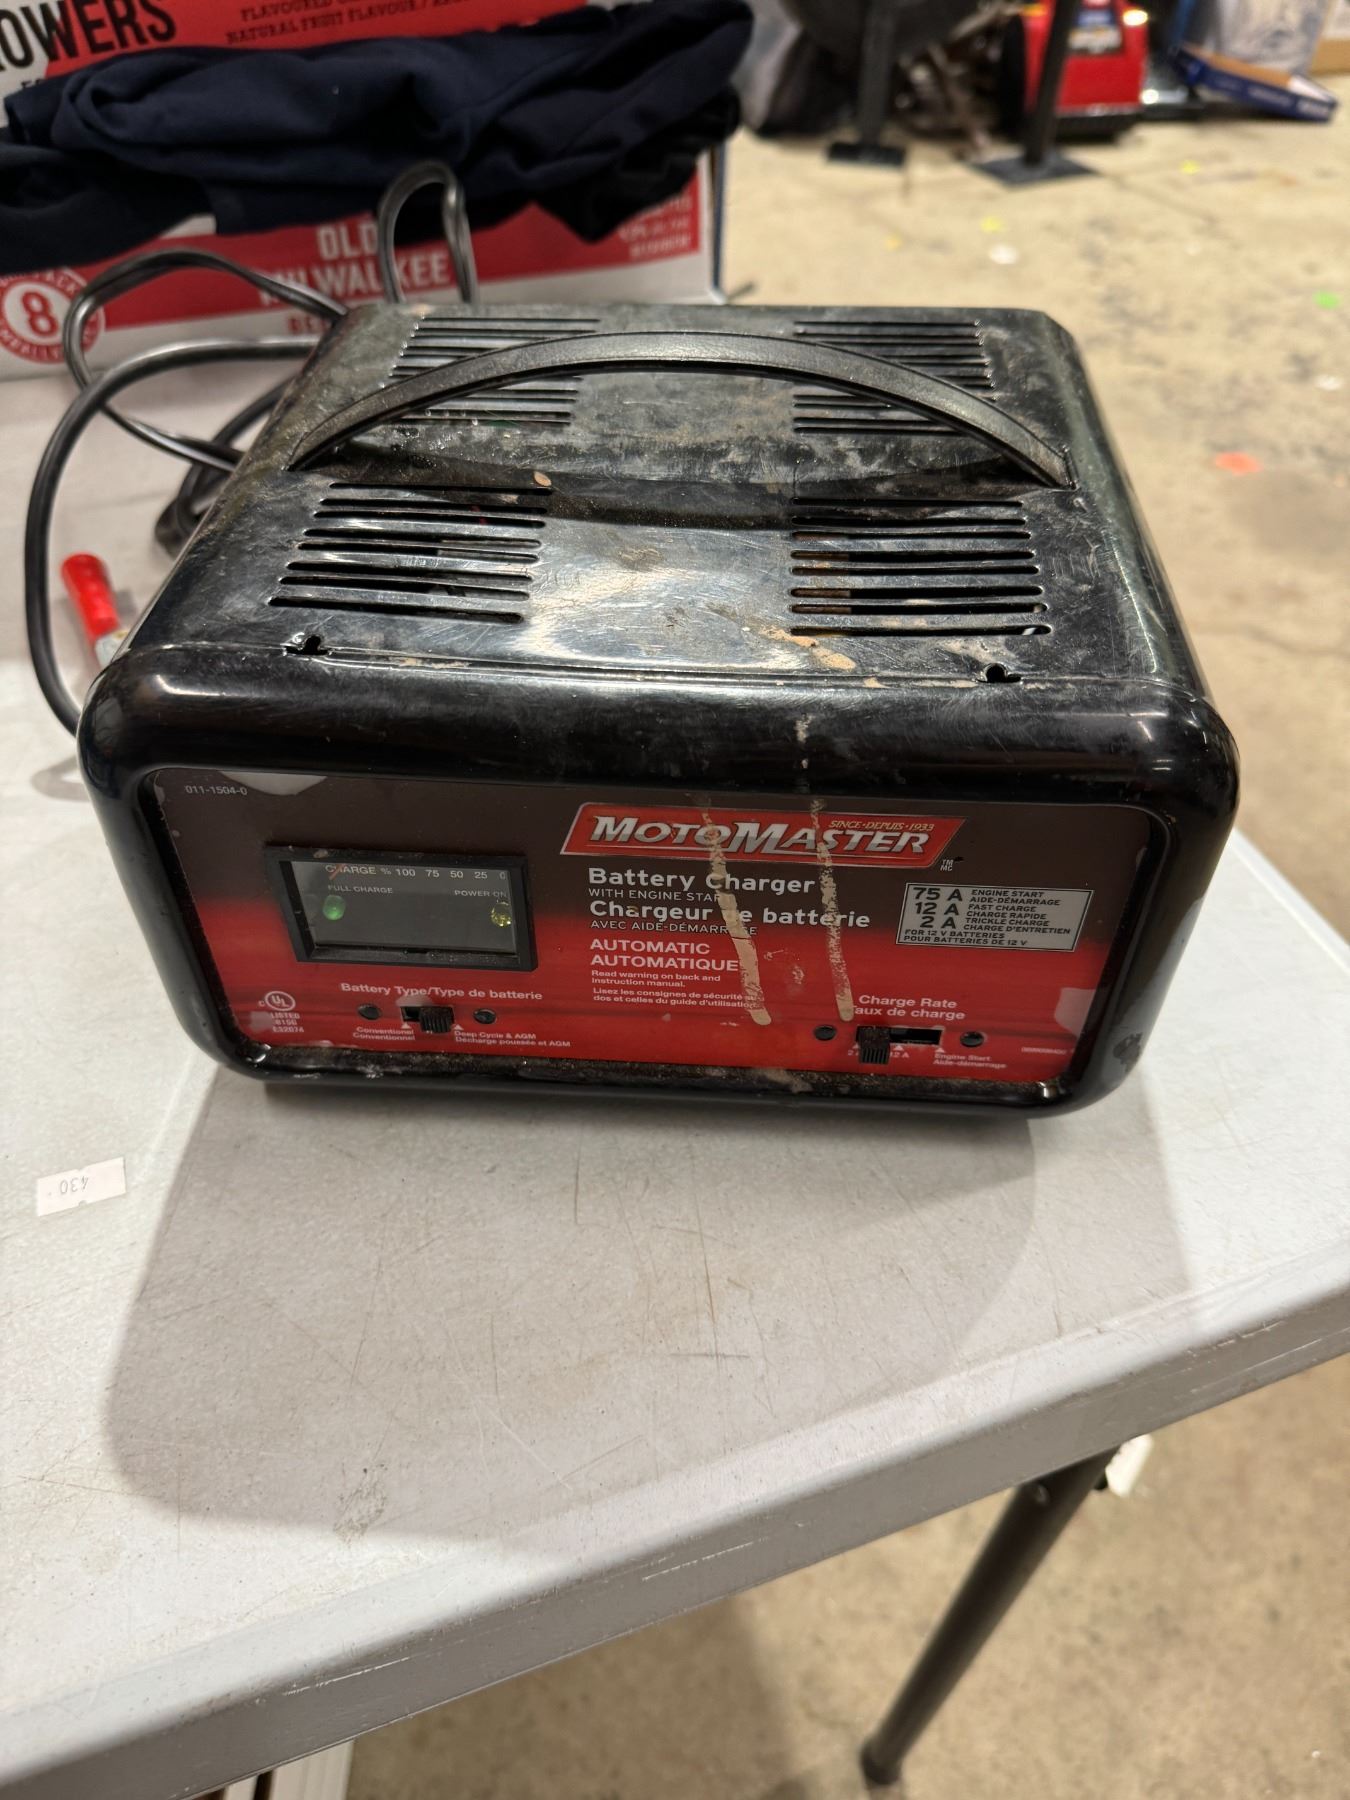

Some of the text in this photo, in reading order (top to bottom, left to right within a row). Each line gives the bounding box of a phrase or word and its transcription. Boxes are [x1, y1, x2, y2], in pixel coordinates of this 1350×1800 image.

[0, 0, 176, 72] OWERS
[317, 219, 379, 260] OLD
[22, 291, 60, 337] 8
[185, 785, 248, 796] 011-1504-0
[396, 868, 416, 877] 100
[425, 869, 440, 878] 75
[450, 870, 464, 879] 50
[475, 871, 488, 880] 25
[588, 867, 816, 896] Battery Charger
[353, 886, 393, 894] CHARGE
[454, 889, 490, 897] POWER
[588, 888, 727, 902] WITH ENGINE STA
[913, 887, 963, 901] 75 A
[971, 889, 1044, 898] ENGINE START
[589, 900, 713, 922] Chargeur
[762, 907, 870, 928] batterie
[915, 902, 959, 916] 12 A
[995, 905, 1036, 913] CHARGE
[920, 916, 956, 929] 2 A
[965, 917, 1050, 927] TRICKLE CHARGE
[1008, 912, 1047, 920] RAPIDE
[591, 920, 757, 935] AVEC AIDE-DÉMARRE
[963, 924, 1071, 935] CHARGE D'ENTRETIEN
[933, 936, 989, 945] BATTERIES
[950, 930, 1005, 939] BATTERIES
[590, 938, 711, 955] AUTOMATIC
[590, 954, 739, 972] AUTOMATIQUE
[591, 969, 617, 977] Read
[619, 971, 659, 980] warning
[675, 972, 700, 981] back
[702, 974, 721, 982] and
[647, 979, 686, 987] manual.
[340, 982, 543, 1000] Battery Type/Type de batterie
[593, 987, 618, 995] Lisez
[636, 989, 687, 999] consignes
[593, 994, 612, 1002] dos
[670, 998, 698, 1006] guide
[858, 994, 957, 1009] Charge Rate
[887, 1006, 906, 1017] de
[910, 1007, 965, 1020] charge
[454, 1030, 477, 1039] Deep
